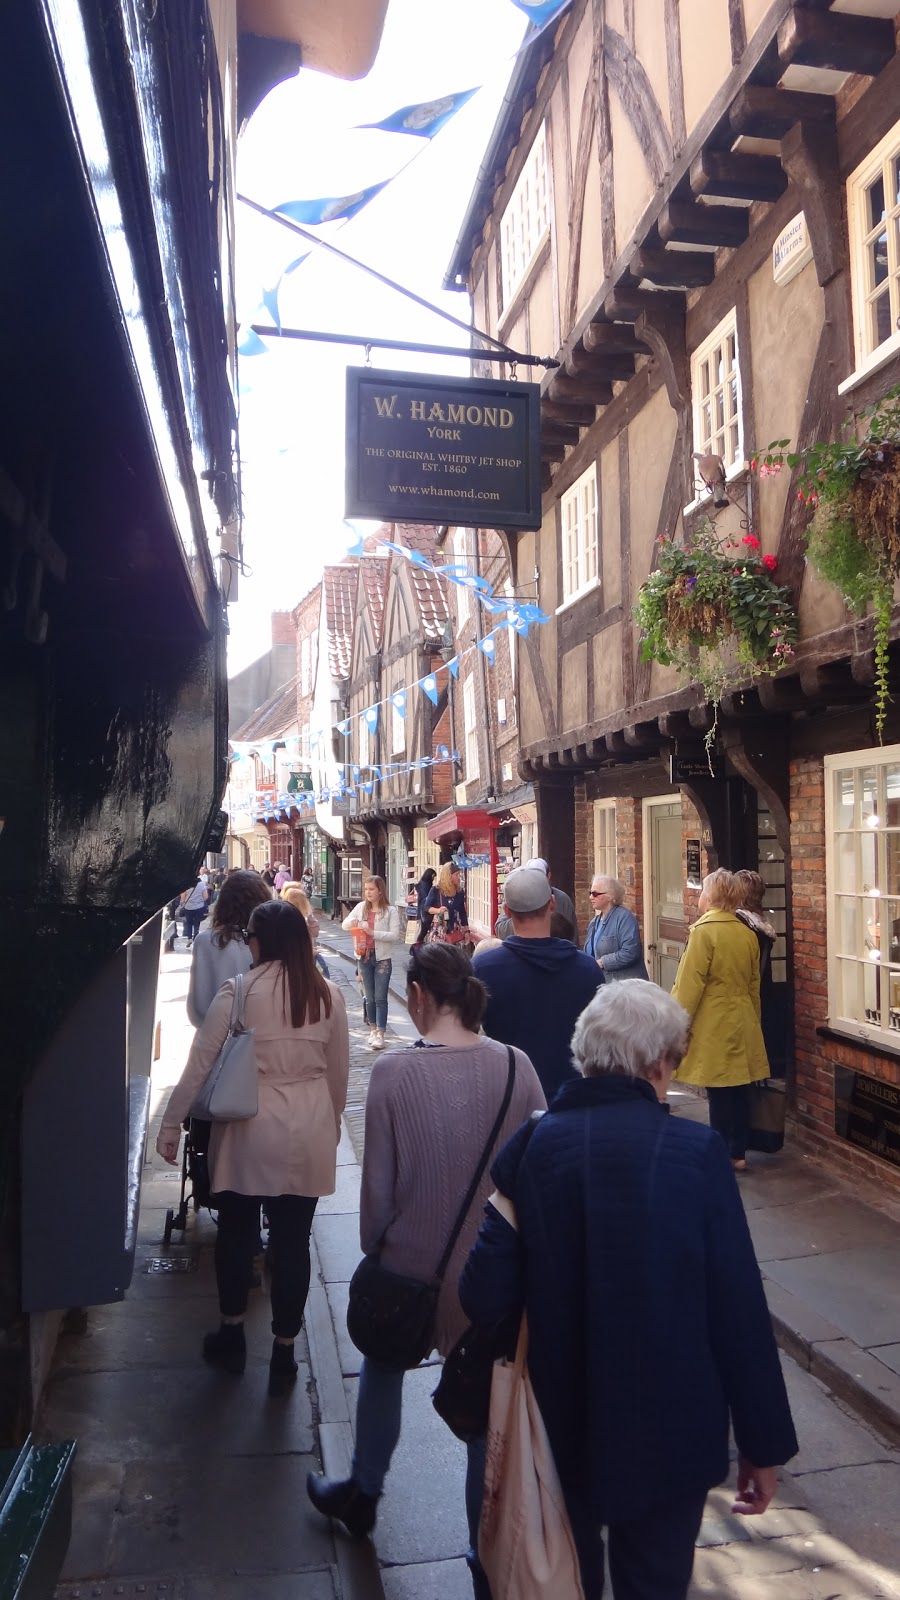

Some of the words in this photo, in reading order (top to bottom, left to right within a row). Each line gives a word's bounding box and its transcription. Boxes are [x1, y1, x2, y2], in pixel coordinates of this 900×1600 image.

[779, 222, 802, 248] Minster
[780, 235, 803, 259] Alarms
[374, 394, 402, 418] W.
[410, 400, 514, 429] HAMOND
[427, 426, 462, 440] YORK
[365, 447, 385, 457] THE
[387, 449, 435, 461] ORIGINAL
[437, 453, 477, 464] WHITBY
[478, 456, 494, 467] JET
[495, 458, 522, 468] SHOP
[422, 462, 441, 472] EST.
[444, 464, 468, 474] 1860
[388, 484, 500, 500] www.whamond.com
[702, 829, 711, 842] 42
[855, 1078, 898, 1104] JEWELLERS
